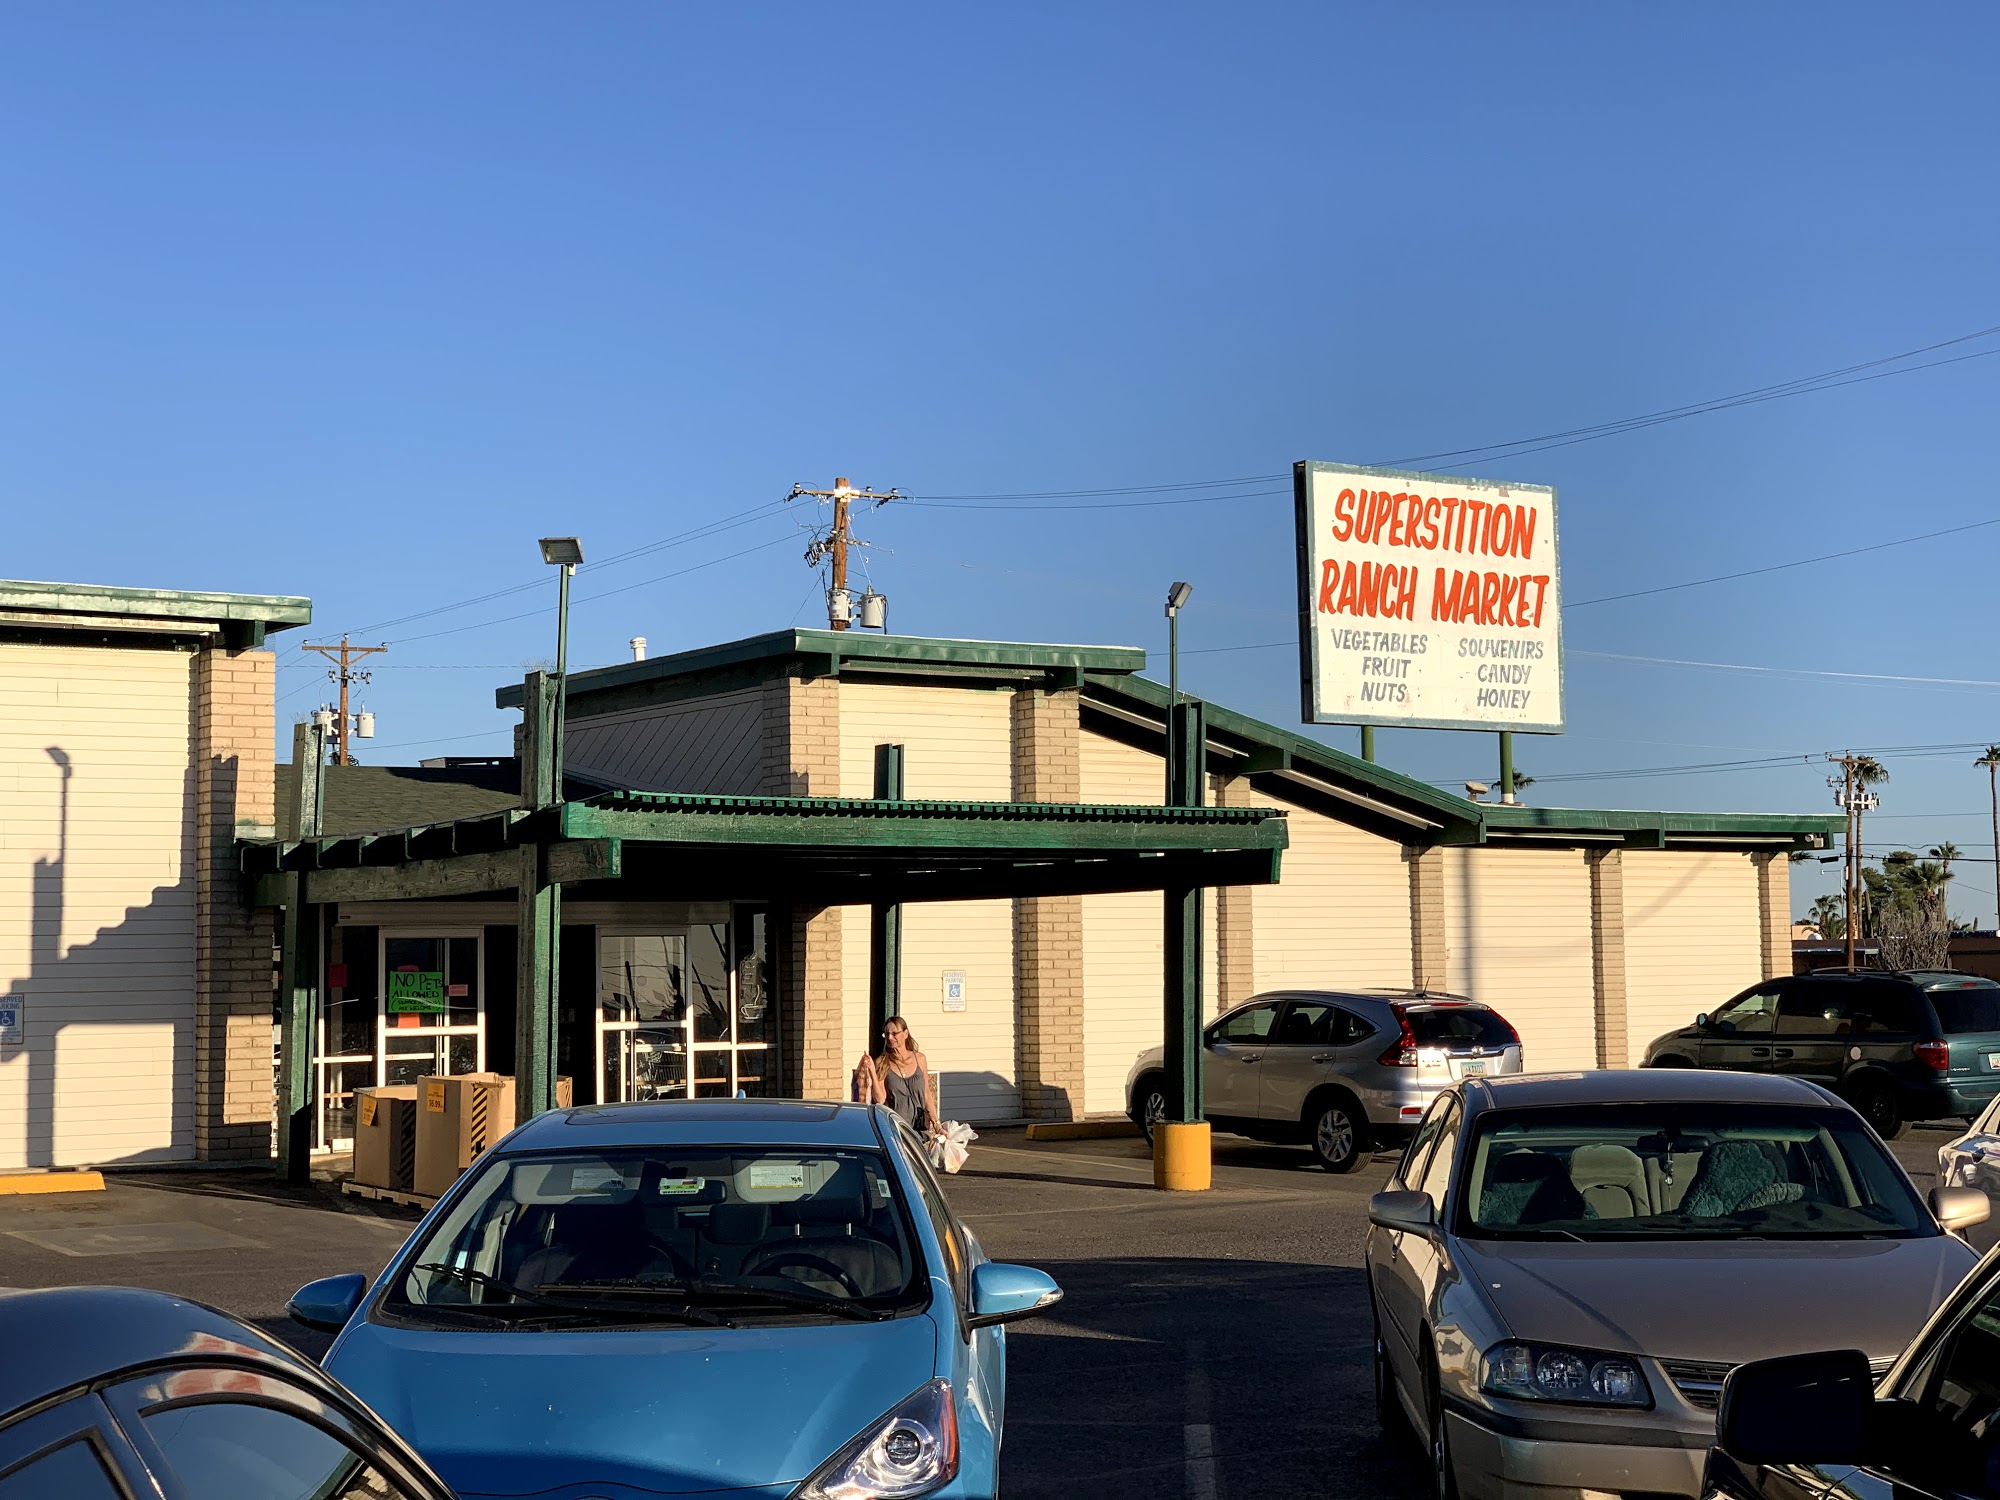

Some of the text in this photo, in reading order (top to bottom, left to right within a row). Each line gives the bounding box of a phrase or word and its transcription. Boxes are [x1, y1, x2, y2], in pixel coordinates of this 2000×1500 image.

[1331, 488, 1537, 560] SUPERSTITION
[1318, 558, 1550, 629] RANCH MARKET
[1330, 628, 1428, 655] VEGETABLES
[1457, 637, 1544, 660] SOUVENIRS
[1361, 656, 1412, 679] FRUIT
[1477, 664, 1532, 685] CANDY
[1360, 681, 1407, 703] NUTS
[1476, 688, 1531, 709] HONEY
[394, 973, 415, 987] NO
[392, 990, 440, 998] ALLOWED
